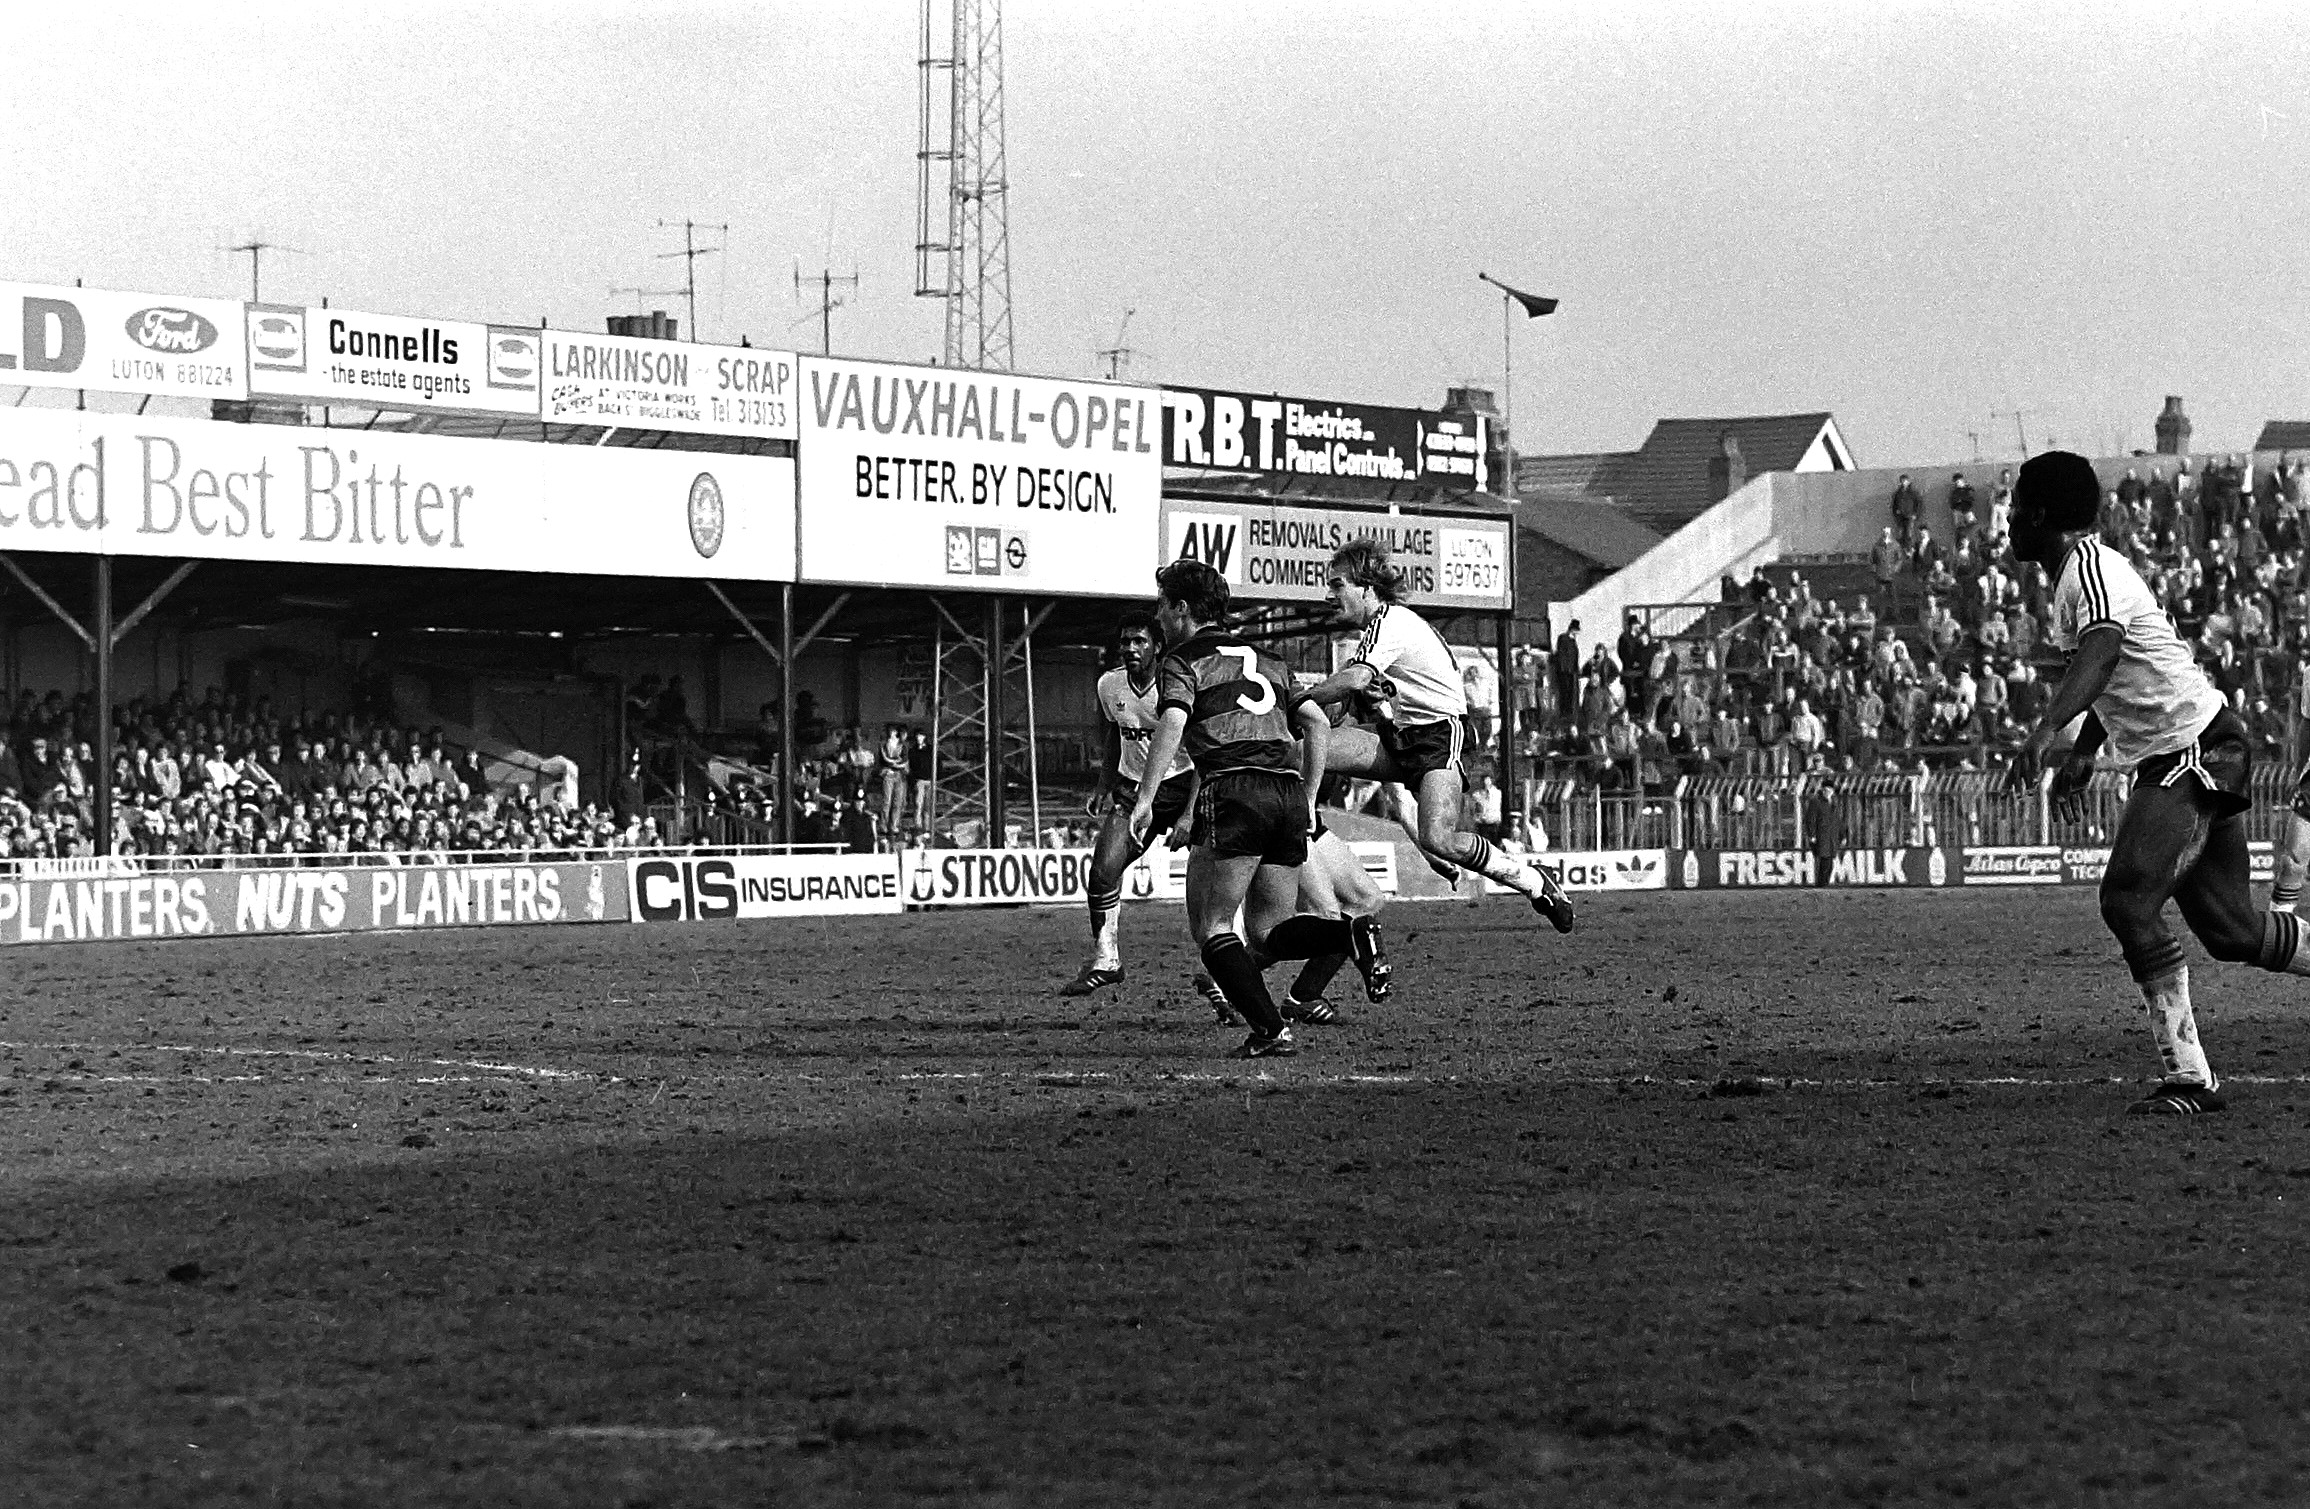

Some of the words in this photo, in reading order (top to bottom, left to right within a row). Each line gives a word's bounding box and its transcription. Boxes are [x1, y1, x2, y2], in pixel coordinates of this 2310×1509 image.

[0, 296, 86, 373] D
[139, 310, 200, 351] Ford
[329, 318, 458, 364] Connells
[112, 359, 165, 381] LUTON
[177, 364, 233, 386] 881224
[361, 368, 406, 388] estate
[412, 374, 471, 399] agents
[551, 343, 688, 387] LARKINSON
[717, 357, 790, 395] SCRAP
[738, 399, 786, 427] 313133
[811, 370, 1151, 453] VAUXHALL-OPEL
[1173, 391, 1284, 470] R.B.T.
[1285, 438, 1332, 475] Panel
[0, 435, 109, 530] ead
[135, 435, 276, 538] Best
[298, 445, 474, 548] Bitter
[856, 454, 965, 503] BETTER.
[972, 462, 1007, 506] BY
[1017, 466, 1117, 513] DESIGN.
[1180, 522, 1237, 576] AW
[1250, 519, 1341, 551] REMOVALS
[1451, 539, 1493, 558] LUTON
[1391, 564, 1435, 593] AIRS
[1445, 562, 1500, 588] 597637
[1216, 646, 1277, 716] 3
[941, 853, 1093, 898] STRONGBO
[1719, 851, 1816, 886] FRESH
[1828, 849, 1908, 884] MILK
[0, 877, 208, 941] PLANTERS
[236, 871, 350, 932] NUTS
[372, 867, 562, 926] PLANTERS
[635, 859, 738, 922] CIS
[742, 874, 896, 903] INSURANCE
